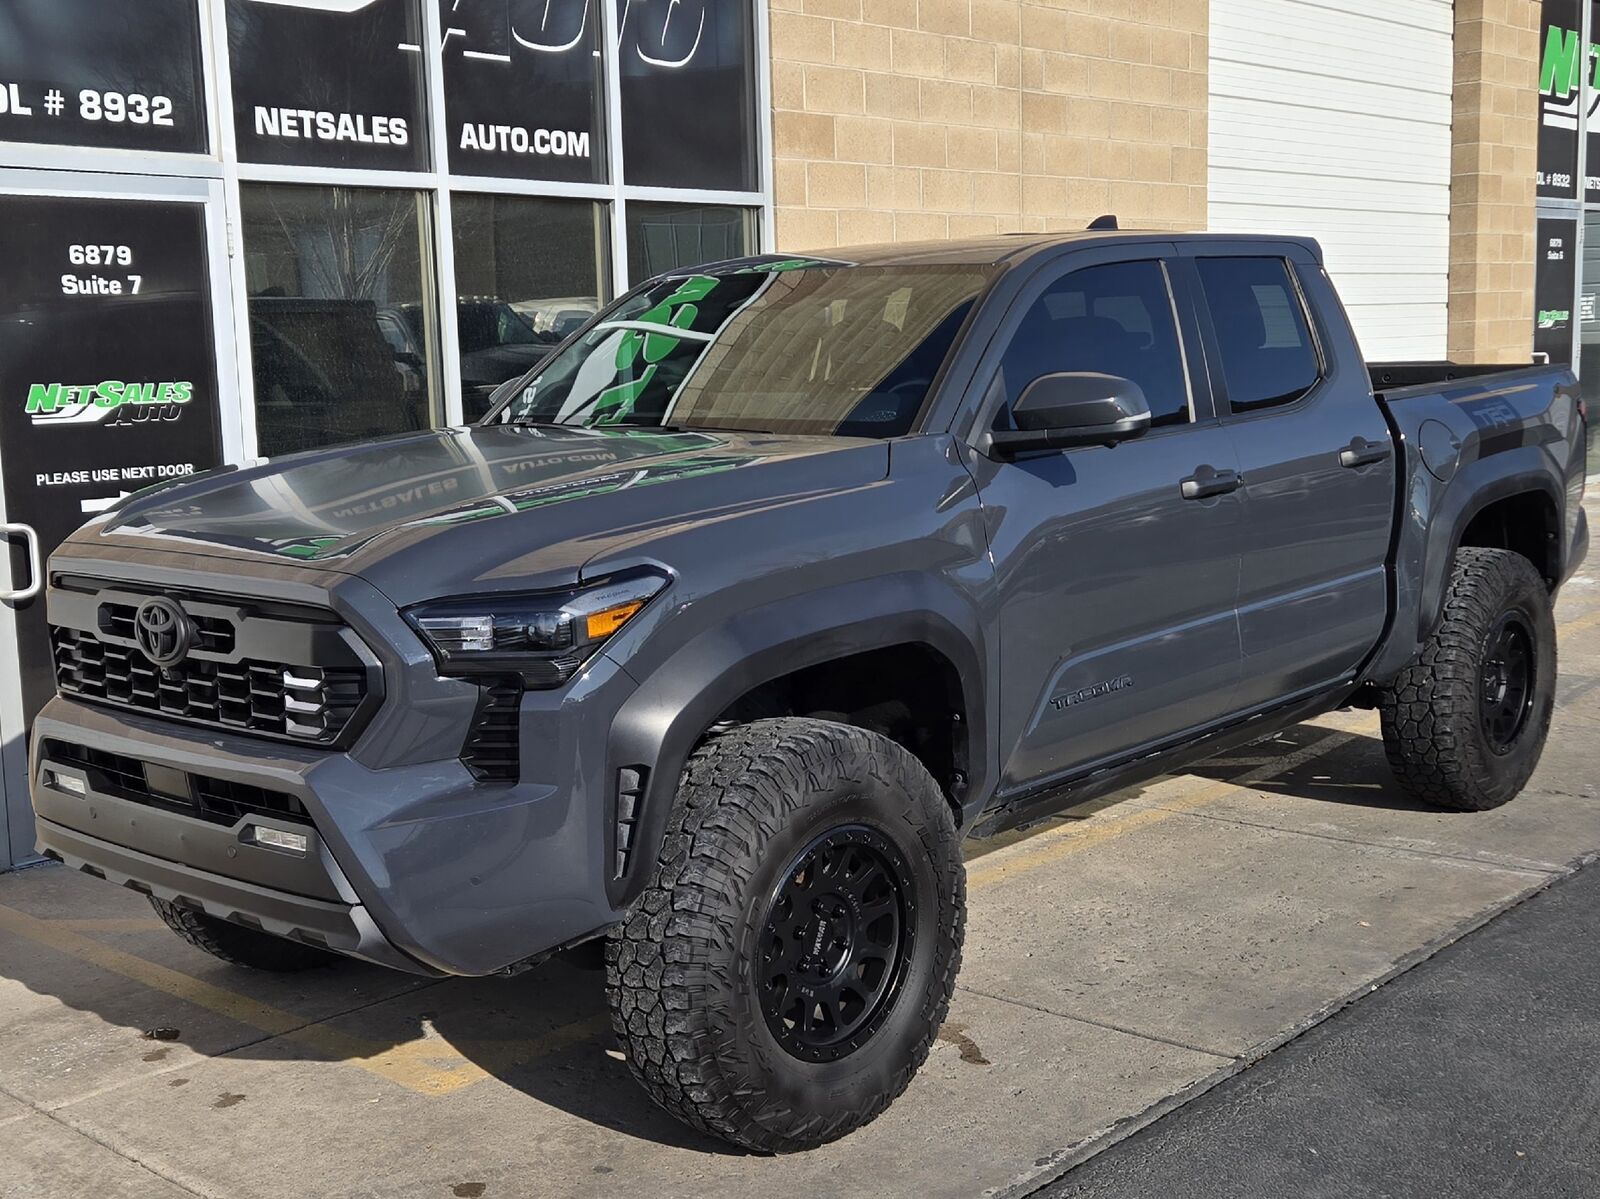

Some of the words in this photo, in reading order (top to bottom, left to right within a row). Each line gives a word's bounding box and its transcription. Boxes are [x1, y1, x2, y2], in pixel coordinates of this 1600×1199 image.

[43, 89, 65, 116] #
[79, 89, 174, 127] 8932
[254, 105, 408, 145] NETSALES
[460, 122, 590, 157] AUTO.COM
[69, 244, 132, 265] 6879
[61, 274, 123, 295] Suite
[127, 275, 142, 295] 7
[36, 471, 90, 486] PLEASE
[91, 468, 119, 481] USE
[121, 466, 155, 479] NEXT
[157, 463, 194, 476] DOOR
